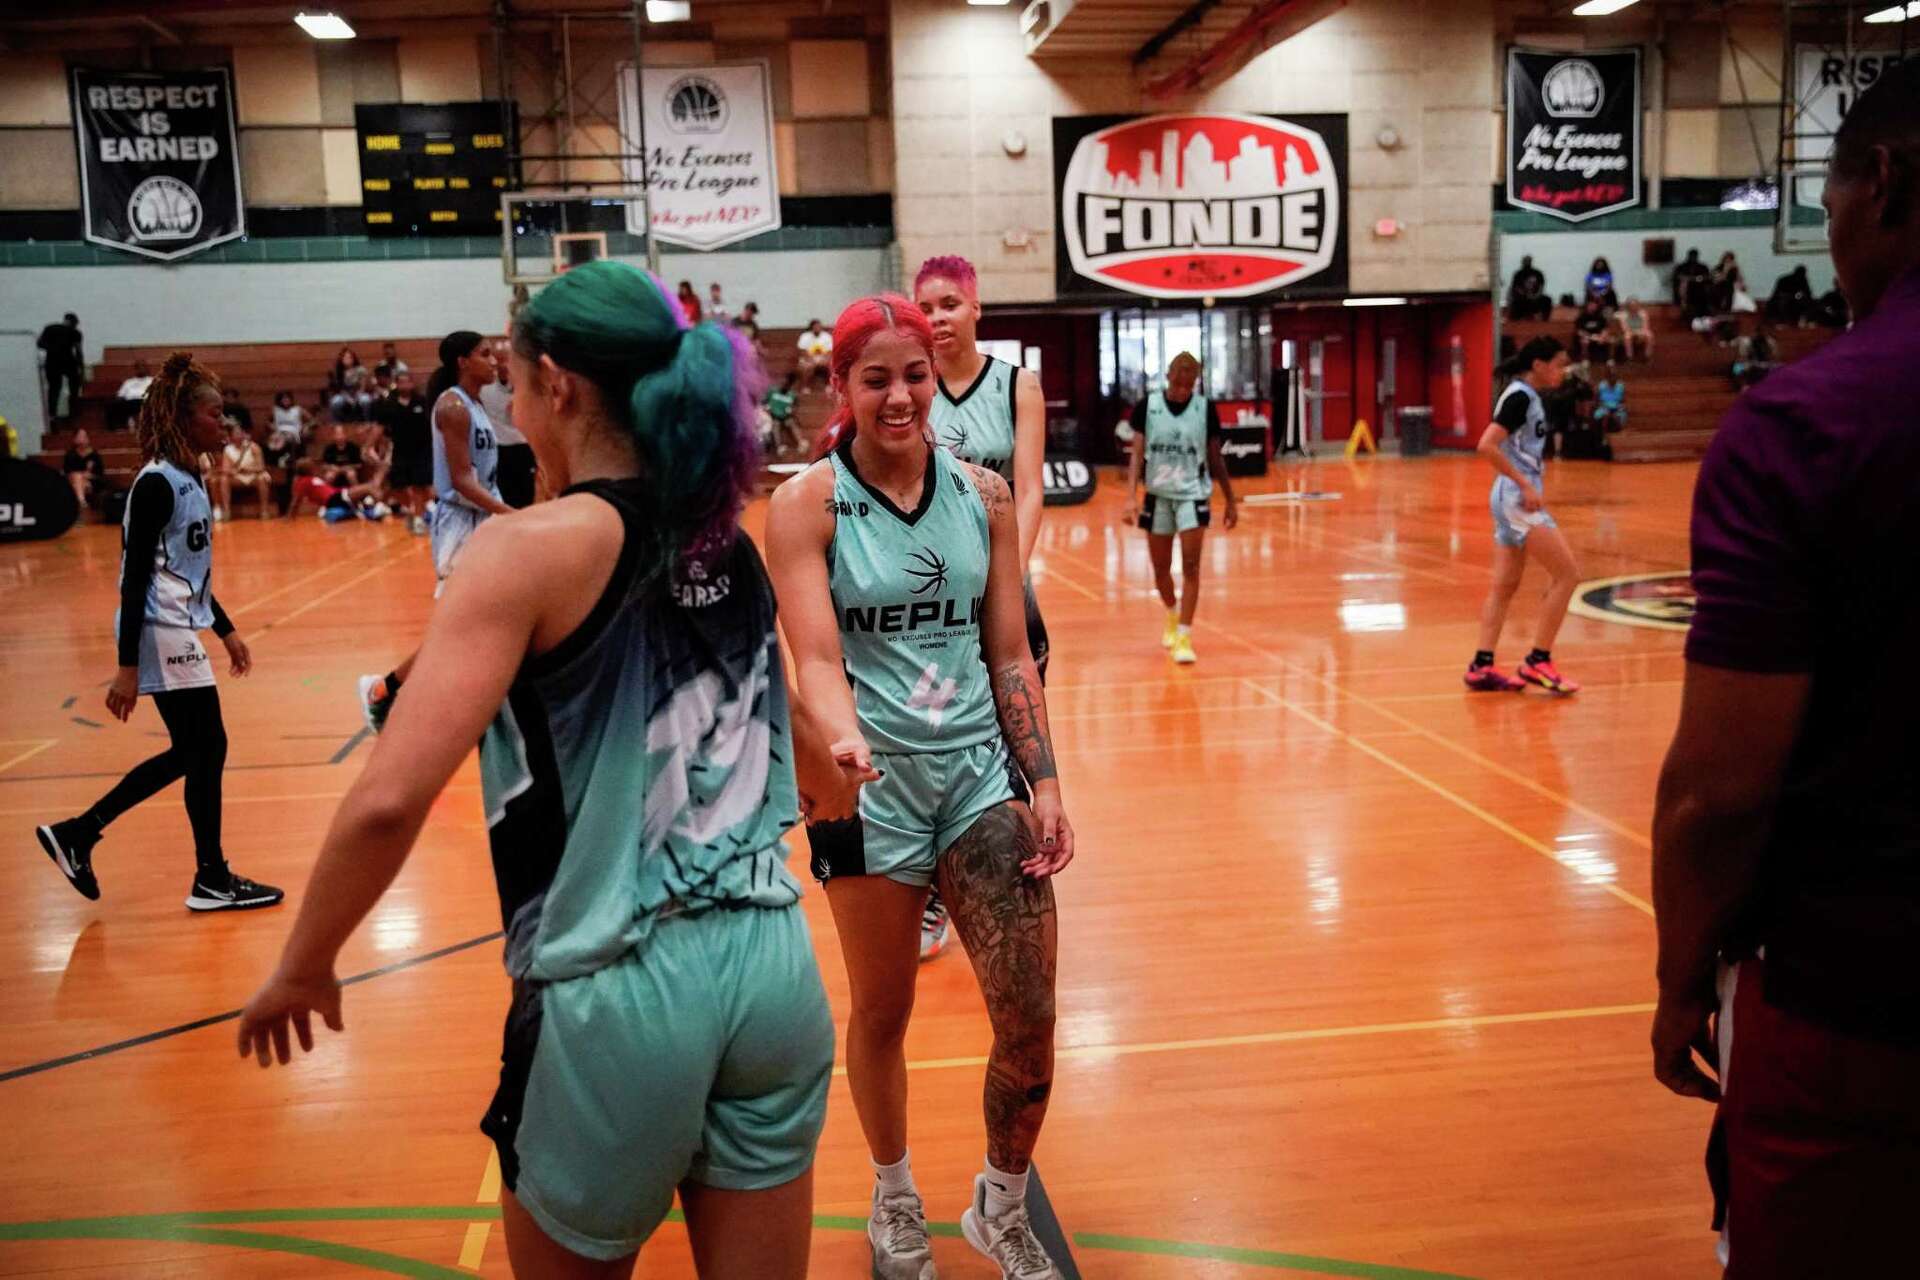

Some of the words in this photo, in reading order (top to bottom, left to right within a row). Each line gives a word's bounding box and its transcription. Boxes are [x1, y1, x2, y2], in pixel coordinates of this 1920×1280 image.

[88, 84, 218, 110] RESPECT
[140, 111, 171, 136] IS
[100, 135, 219, 162] EARNED
[1084, 189, 1319, 257] FONDE
[906, 662, 961, 737] 4
